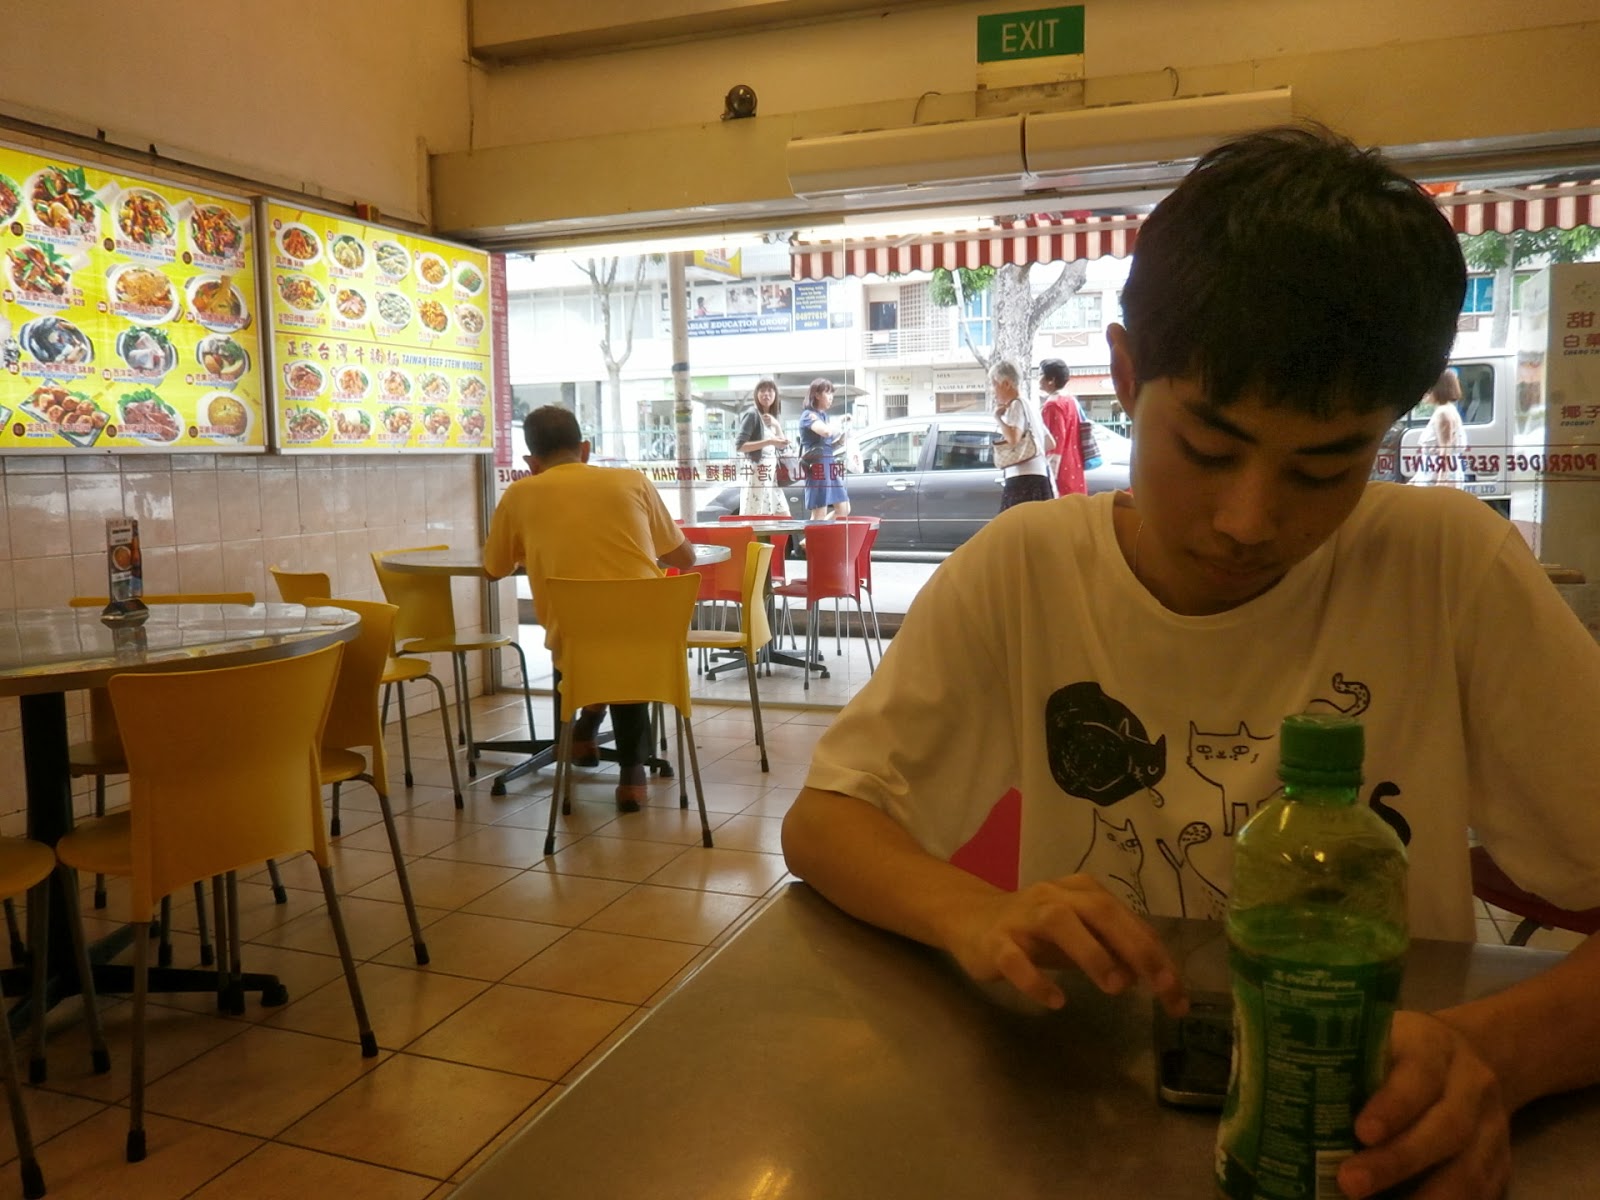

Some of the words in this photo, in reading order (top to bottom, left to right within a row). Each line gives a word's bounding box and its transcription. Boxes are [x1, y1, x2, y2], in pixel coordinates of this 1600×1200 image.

[1001, 19, 1060, 53] EXIT
[711, 319, 758, 329] EDUCATION
[759, 317, 788, 326] GROUP
[402, 353, 427, 367] TAIWAN
[428, 356, 443, 368] BEEF
[444, 358, 461, 369] STEW
[462, 360, 483, 371] NOODLE
[1480, 484, 1496, 494] LTD
